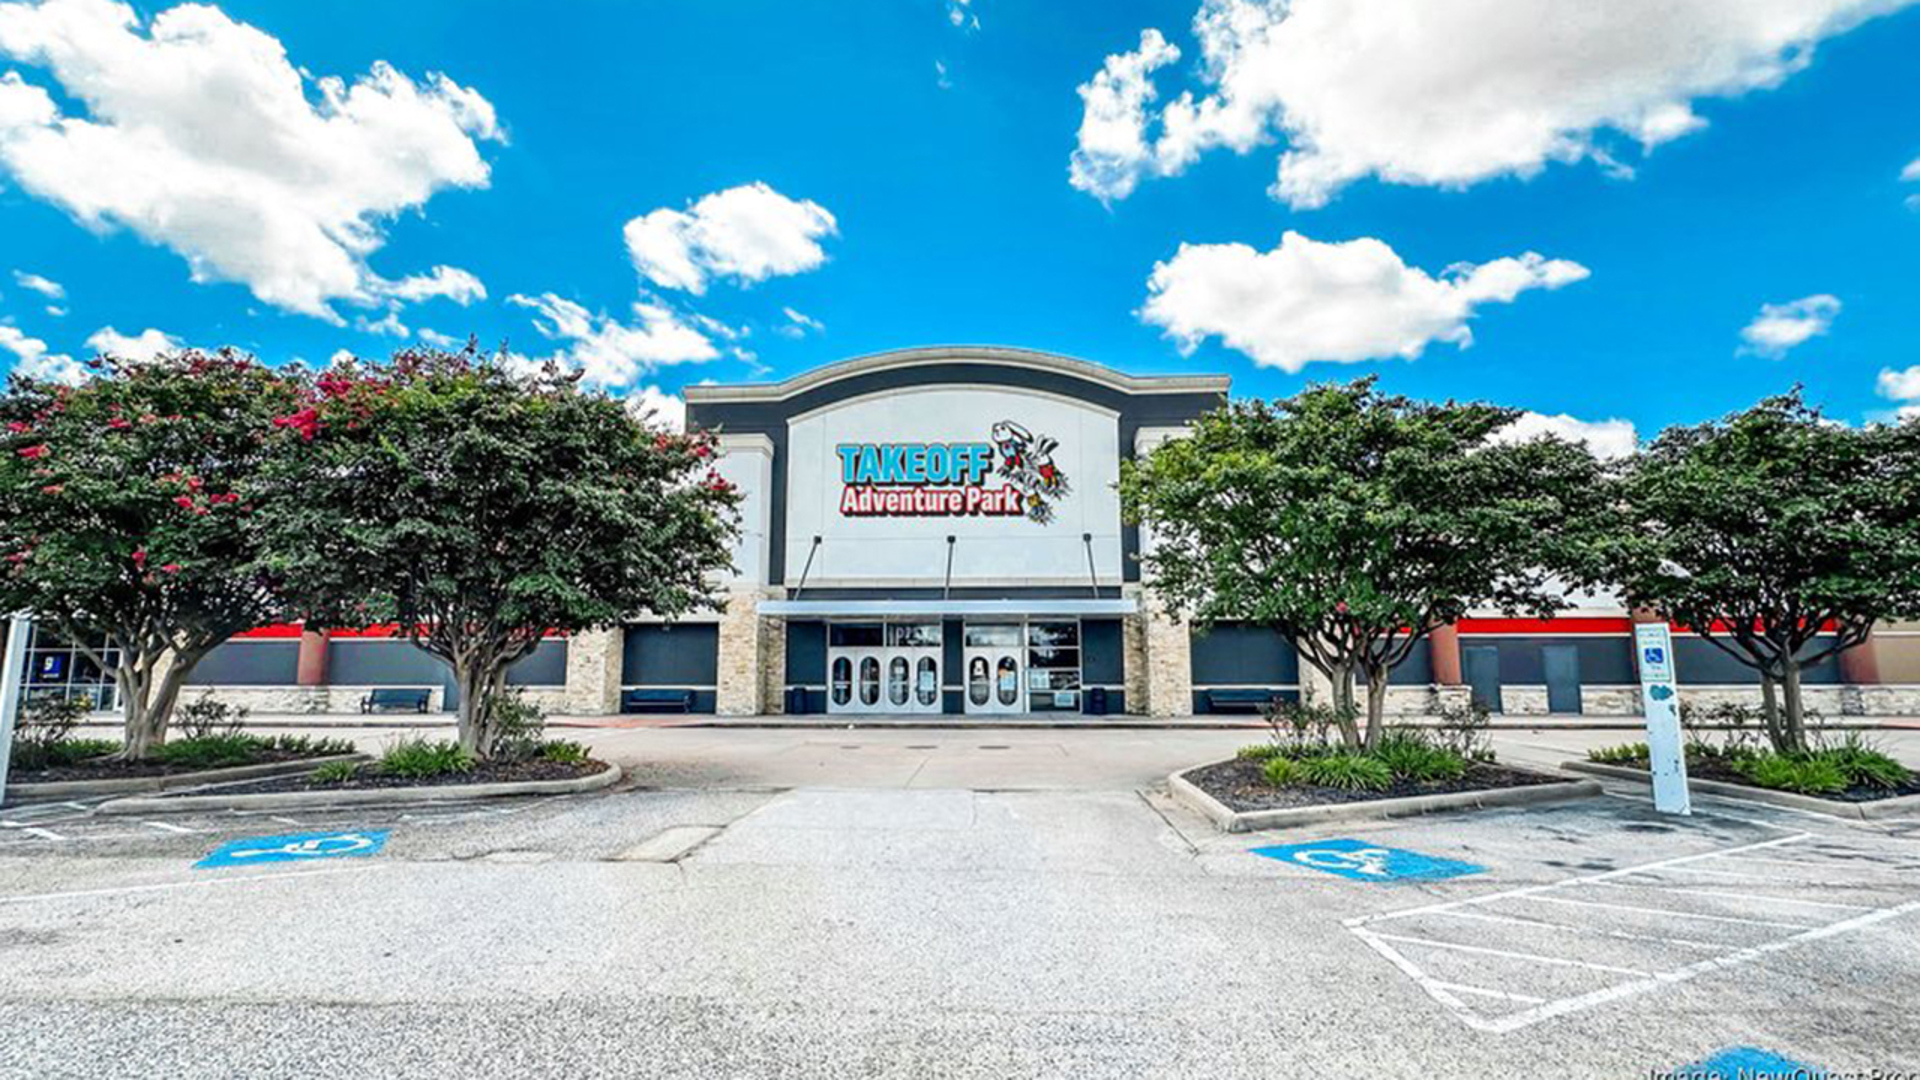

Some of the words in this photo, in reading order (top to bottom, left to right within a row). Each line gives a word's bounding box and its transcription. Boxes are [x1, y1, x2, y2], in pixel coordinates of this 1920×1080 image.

[837, 444, 992, 485] TAKEOFF
[841, 486, 962, 514] Adventure
[965, 484, 1022, 513] Park
